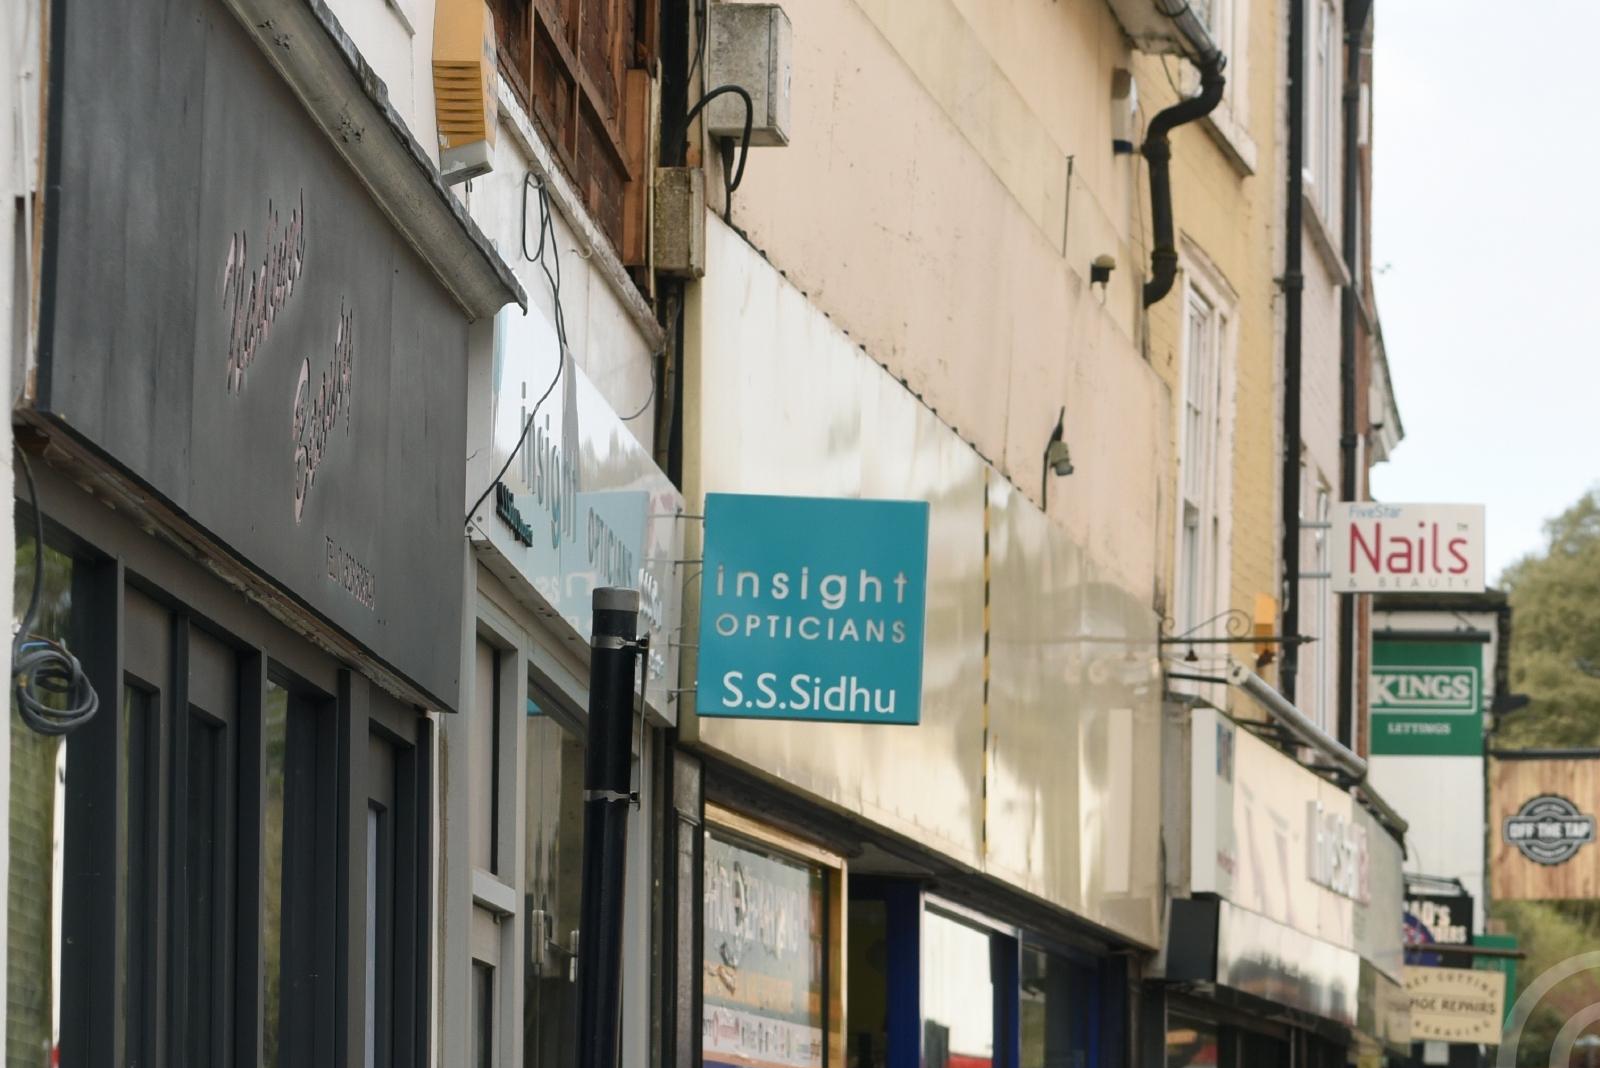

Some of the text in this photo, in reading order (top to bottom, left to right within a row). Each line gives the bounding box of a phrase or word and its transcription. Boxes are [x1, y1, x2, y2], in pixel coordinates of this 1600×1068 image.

[521, 381, 577, 549] insight
[1349, 521, 1468, 574] Nails
[716, 565, 908, 610] insight
[1378, 577, 1469, 587] BEAUTY
[716, 613, 906, 644] OPTICIANS
[722, 671, 896, 713] S.S.Sidhu
[1368, 675, 1470, 704] KINGS
[1388, 722, 1451, 735] LETTINGS
[1405, 974, 1429, 989] KEY
[1441, 999, 1496, 1014] REPAIRS
